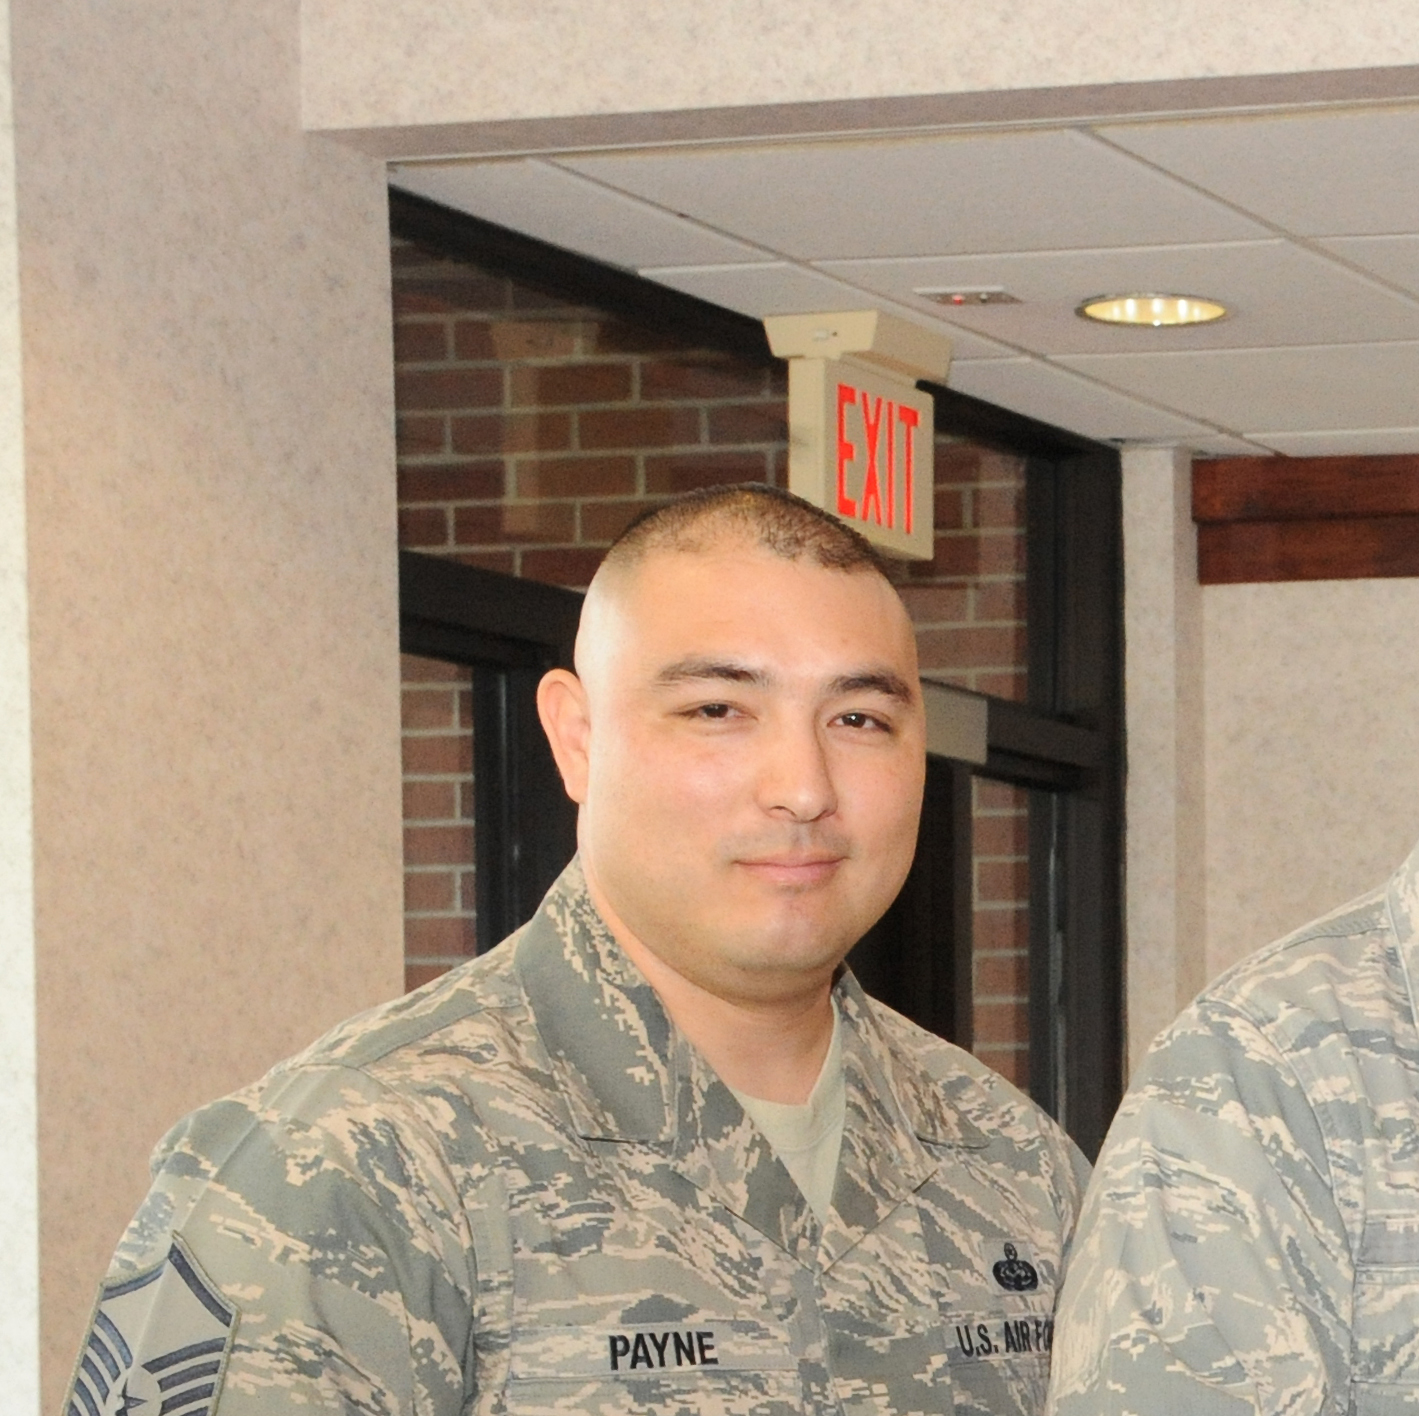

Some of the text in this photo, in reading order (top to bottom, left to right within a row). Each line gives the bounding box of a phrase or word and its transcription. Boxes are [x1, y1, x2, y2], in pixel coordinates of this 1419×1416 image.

[837, 382, 919, 535] EXIT
[608, 1331, 719, 1371] PAYNE
[956, 1323, 999, 1357] U.S.
[1004, 1320, 1032, 1353] AIR
